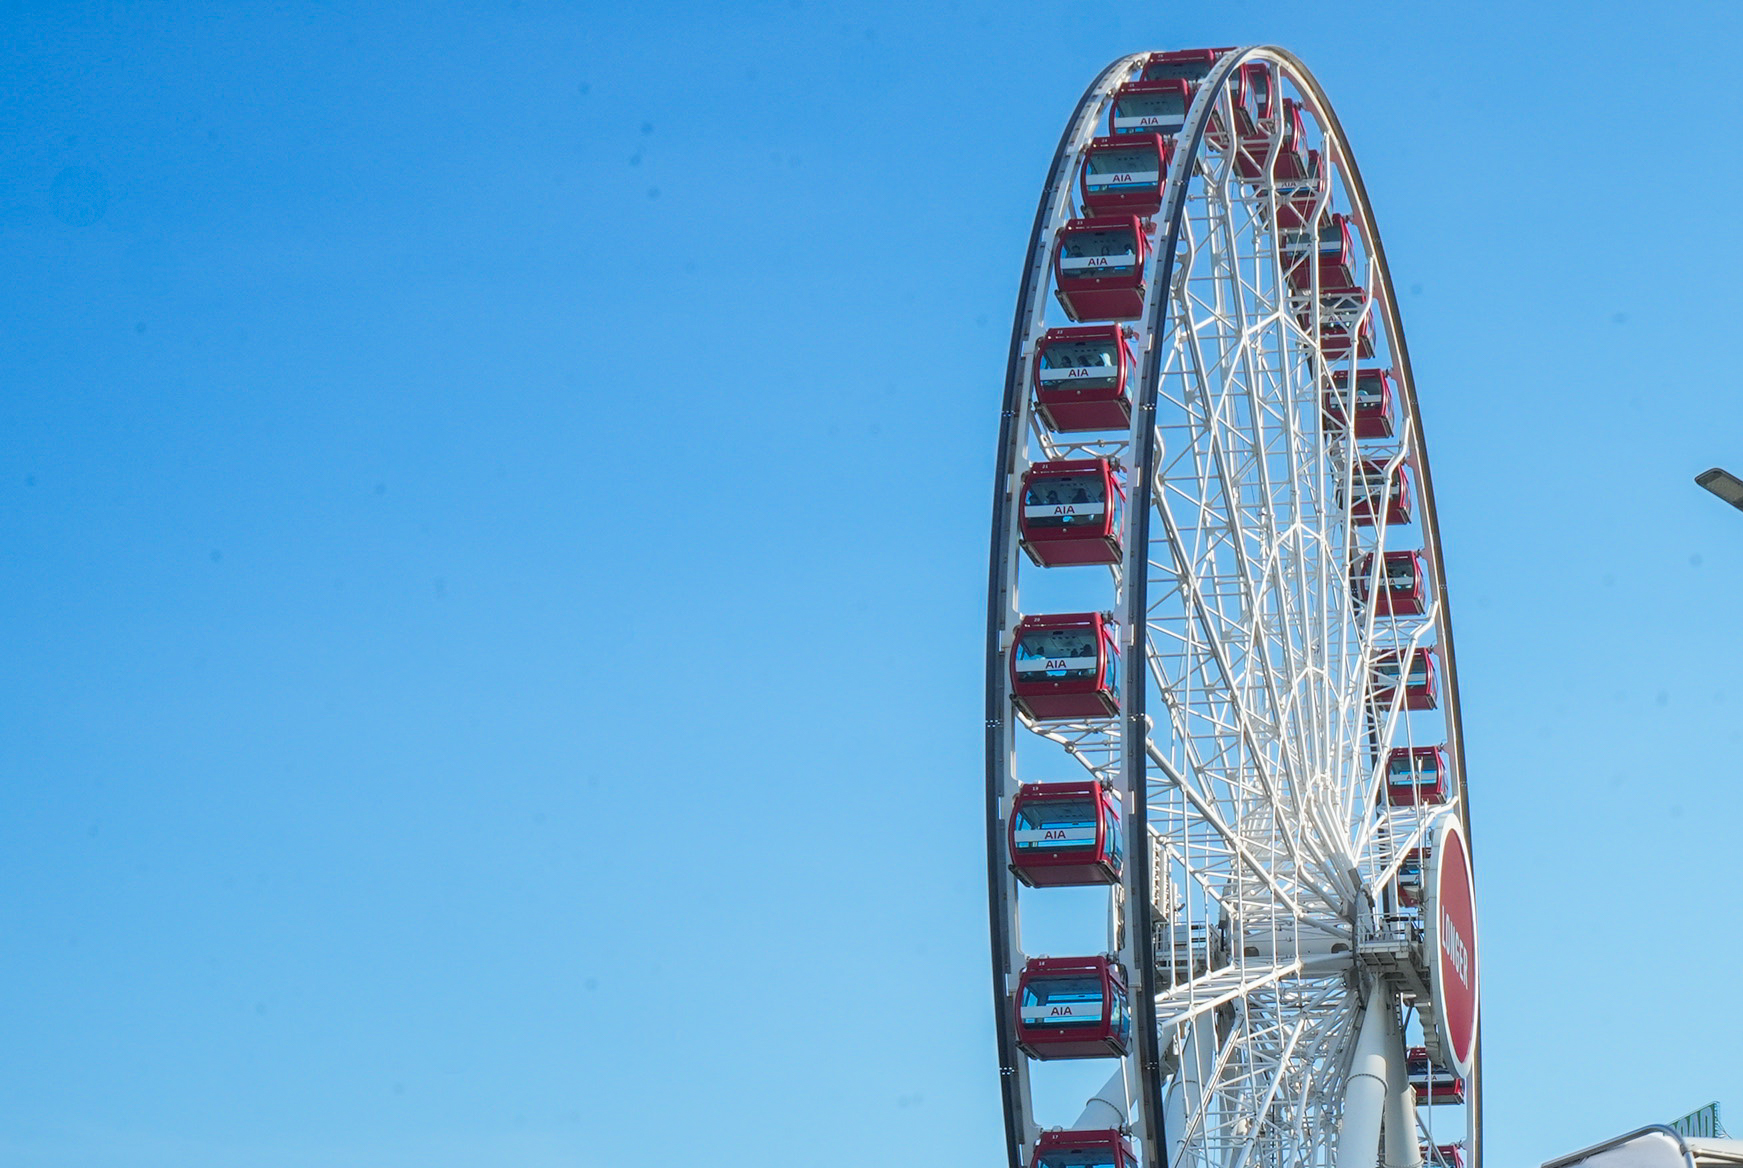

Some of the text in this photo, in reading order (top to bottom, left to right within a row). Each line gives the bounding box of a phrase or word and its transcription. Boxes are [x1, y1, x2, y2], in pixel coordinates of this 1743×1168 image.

[1140, 117, 1159, 126] AIA
[1112, 174, 1132, 183] AIA
[1087, 257, 1108, 266] AIA
[1068, 368, 1089, 377] AIA
[1054, 505, 1075, 515] AIA
[1045, 659, 1067, 669] AIA
[1044, 830, 1067, 840] AIA
[1441, 905, 1469, 990] LONGER
[1050, 1006, 1073, 1016] AIA
